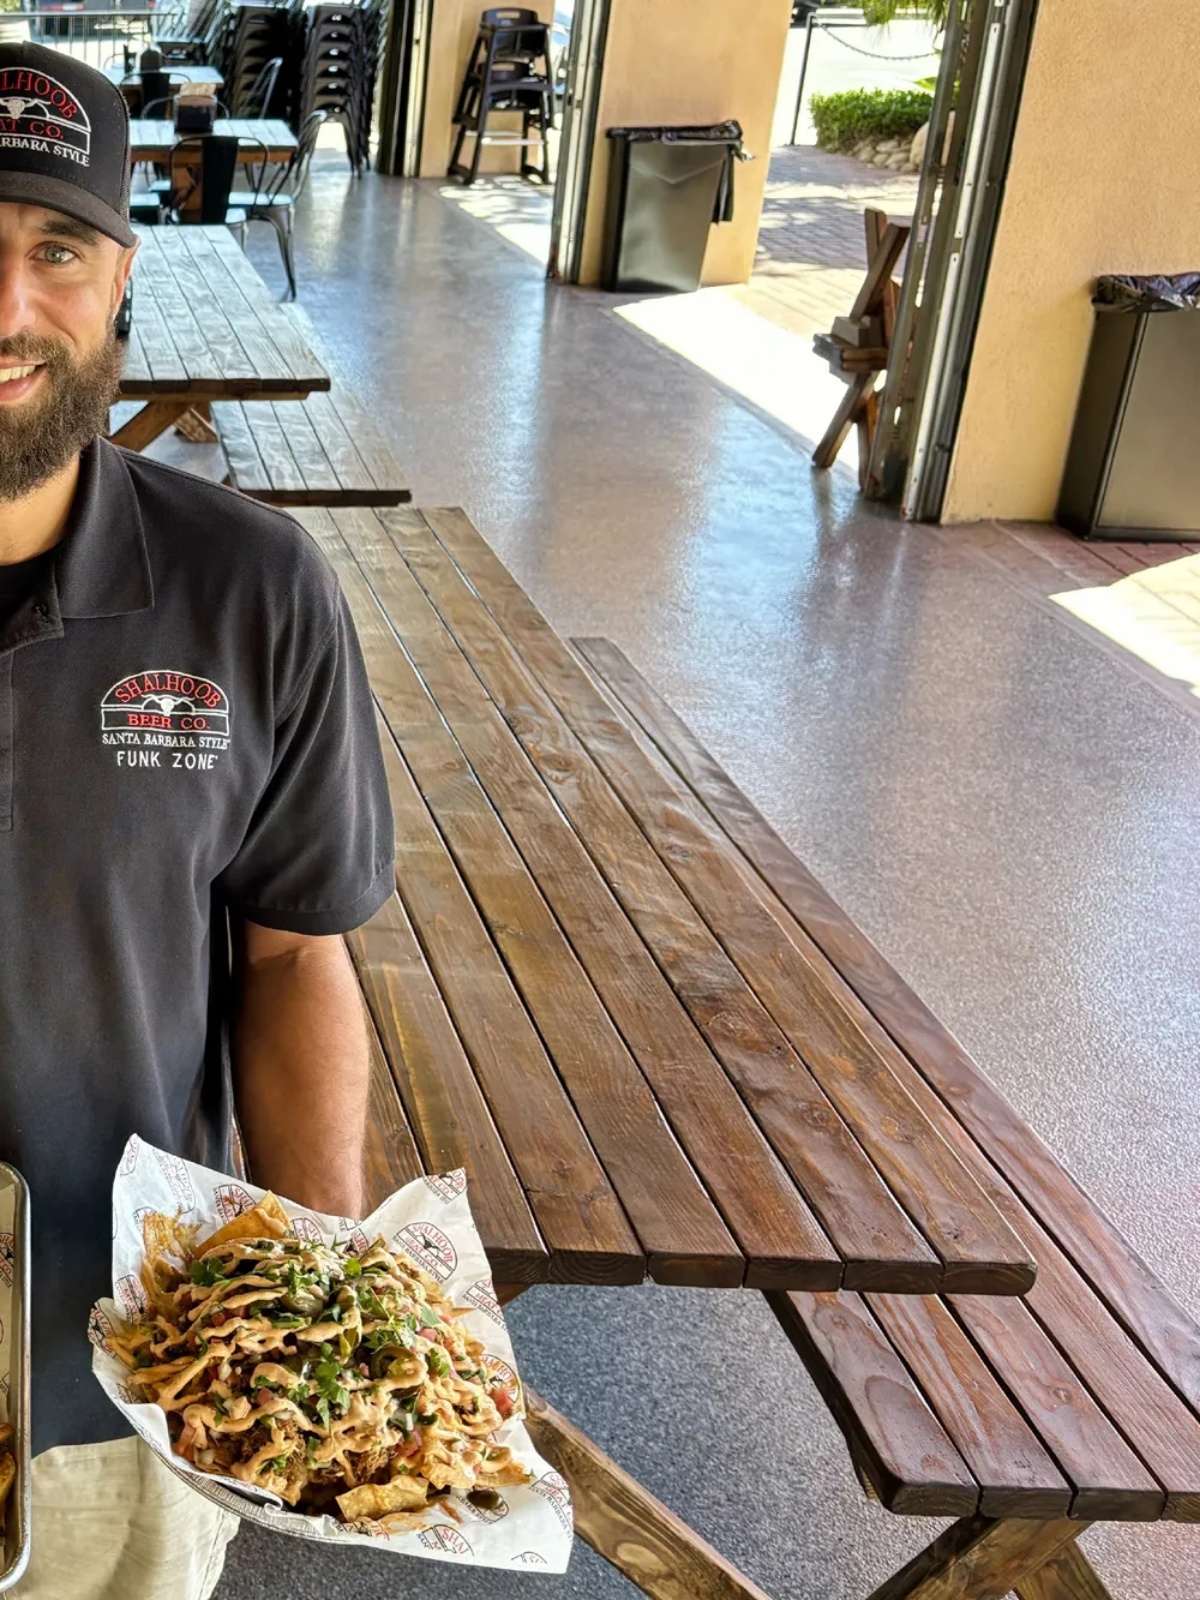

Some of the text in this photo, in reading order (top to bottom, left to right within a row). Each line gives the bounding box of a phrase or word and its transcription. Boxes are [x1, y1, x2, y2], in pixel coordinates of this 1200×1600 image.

[29, 121, 64, 139] CO.
[52, 145, 90, 167] STYLE
[115, 674, 221, 708] SHALHOOB
[127, 713, 172, 728] BEER
[102, 733, 230, 750] SANTA BARBARA STYLE
[117, 750, 218, 770] FUNK ZONE
